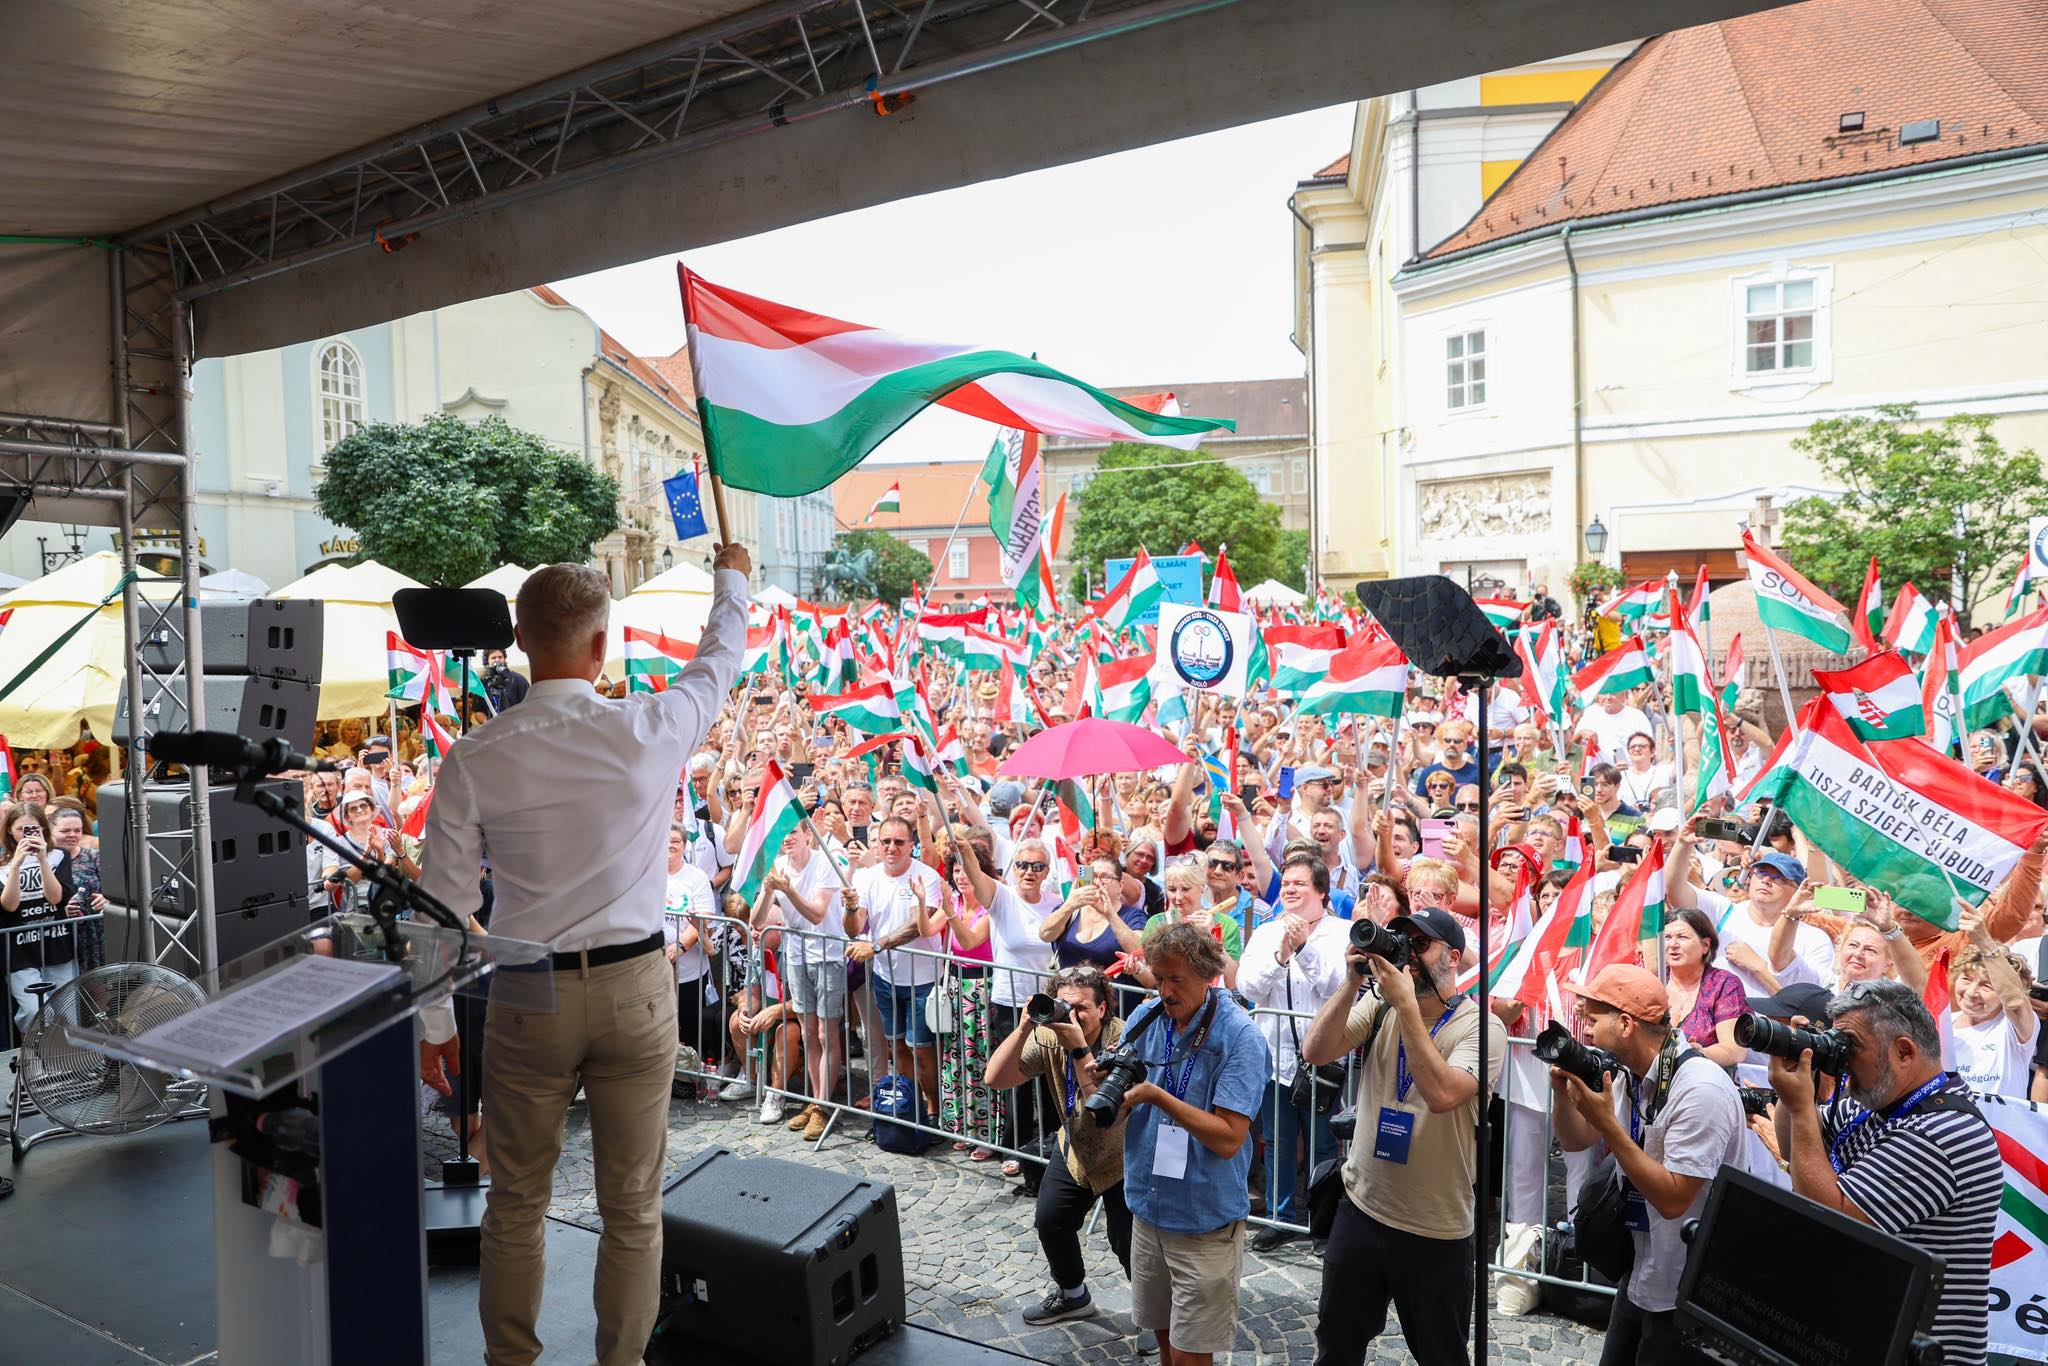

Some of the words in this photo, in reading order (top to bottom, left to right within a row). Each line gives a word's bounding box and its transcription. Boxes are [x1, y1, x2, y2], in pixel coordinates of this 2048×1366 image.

[319, 535, 361, 555] KÁVÉ
[1152, 560, 1187, 569] ÁLMÁN
[1206, 614, 1220, 626] TISZA
[1191, 679, 1208, 687] ZUGLÓ
[1809, 765, 1852, 806] TISZA
[1854, 799, 1920, 844] SZIGET-
[1849, 767, 1920, 816] BARTÓK
[1921, 808, 1968, 845] BÉLA
[1662, 1057, 1670, 1079] NPS
[1961, 1073, 2000, 1083] sségünk
